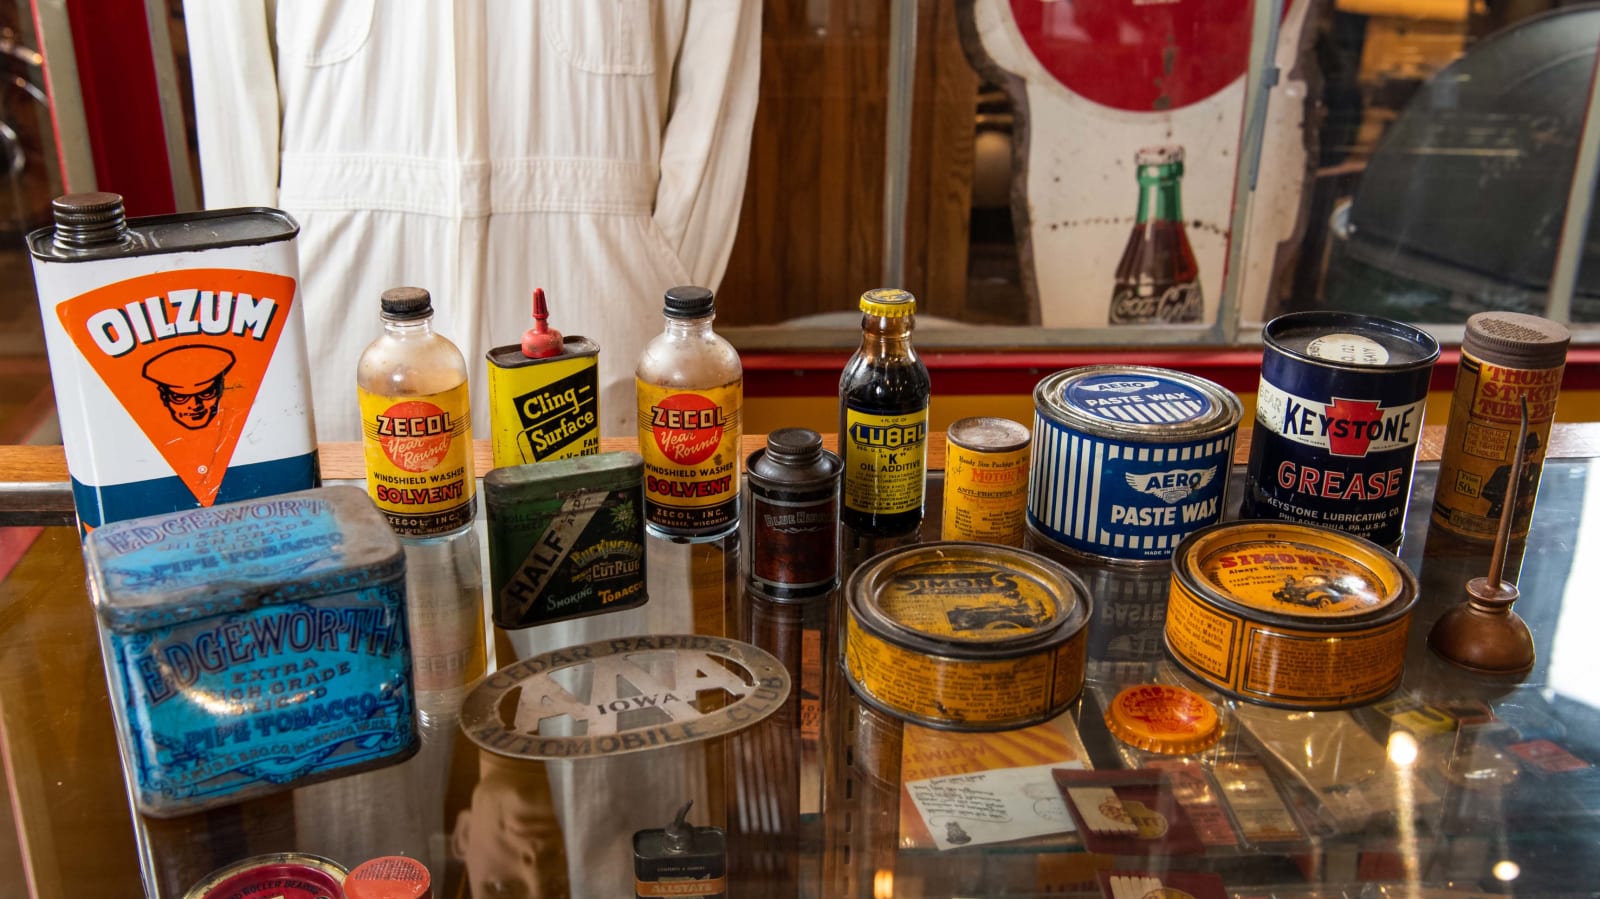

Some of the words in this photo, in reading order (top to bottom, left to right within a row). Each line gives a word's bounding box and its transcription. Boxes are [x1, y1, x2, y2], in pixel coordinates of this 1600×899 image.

[86, 288, 279, 358] OILZUM
[1098, 381, 1145, 390] AERO
[1086, 394, 1145, 406] PASTE
[1149, 392, 1191, 402] WAX
[376, 412, 455, 437] ZECOL
[651, 406, 728, 430] ZECOL
[1283, 397, 1415, 443] KEYSTONE
[531, 411, 594, 452] Surface
[660, 431, 696, 451] Year
[386, 437, 424, 460] Year
[403, 436, 448, 468] Round
[673, 430, 719, 460] Round
[374, 472, 427, 485] WINDSHIELD
[430, 467, 464, 482] WASHER
[645, 463, 696, 477] WINDSHIELD
[699, 462, 734, 477] WASHER
[860, 462, 876, 472] OIL
[881, 459, 921, 473] ADDITIVE
[971, 468, 1015, 483] MOTOR
[377, 479, 464, 504] SOLVENT
[647, 474, 732, 498] SOLVENT
[1144, 472, 1202, 491] AERO
[1278, 460, 1403, 500] GREASE
[1110, 504, 1177, 526] PASTE
[1182, 495, 1218, 523] WAX
[1267, 497, 1319, 518] KEYSTONE
[1323, 511, 1387, 522] LUBRICATING
[105, 499, 335, 554] EDGEWORT
[507, 529, 563, 604] HALF
[1219, 552, 1350, 571] SIMONIZ
[1229, 566, 1259, 576] Always
[137, 606, 396, 706] EDGEWORTH
[486, 646, 592, 690] CEDAR
[609, 635, 733, 654] RAPIDS
[232, 658, 319, 684] EXTRA
[270, 661, 351, 695] GRADE
[473, 722, 706, 755] AUTOMOBILE
[727, 676, 785, 723] CLUB
[596, 692, 682, 715] IOWA
[185, 722, 254, 750] PIPE
[254, 692, 377, 737] TOBACCO
